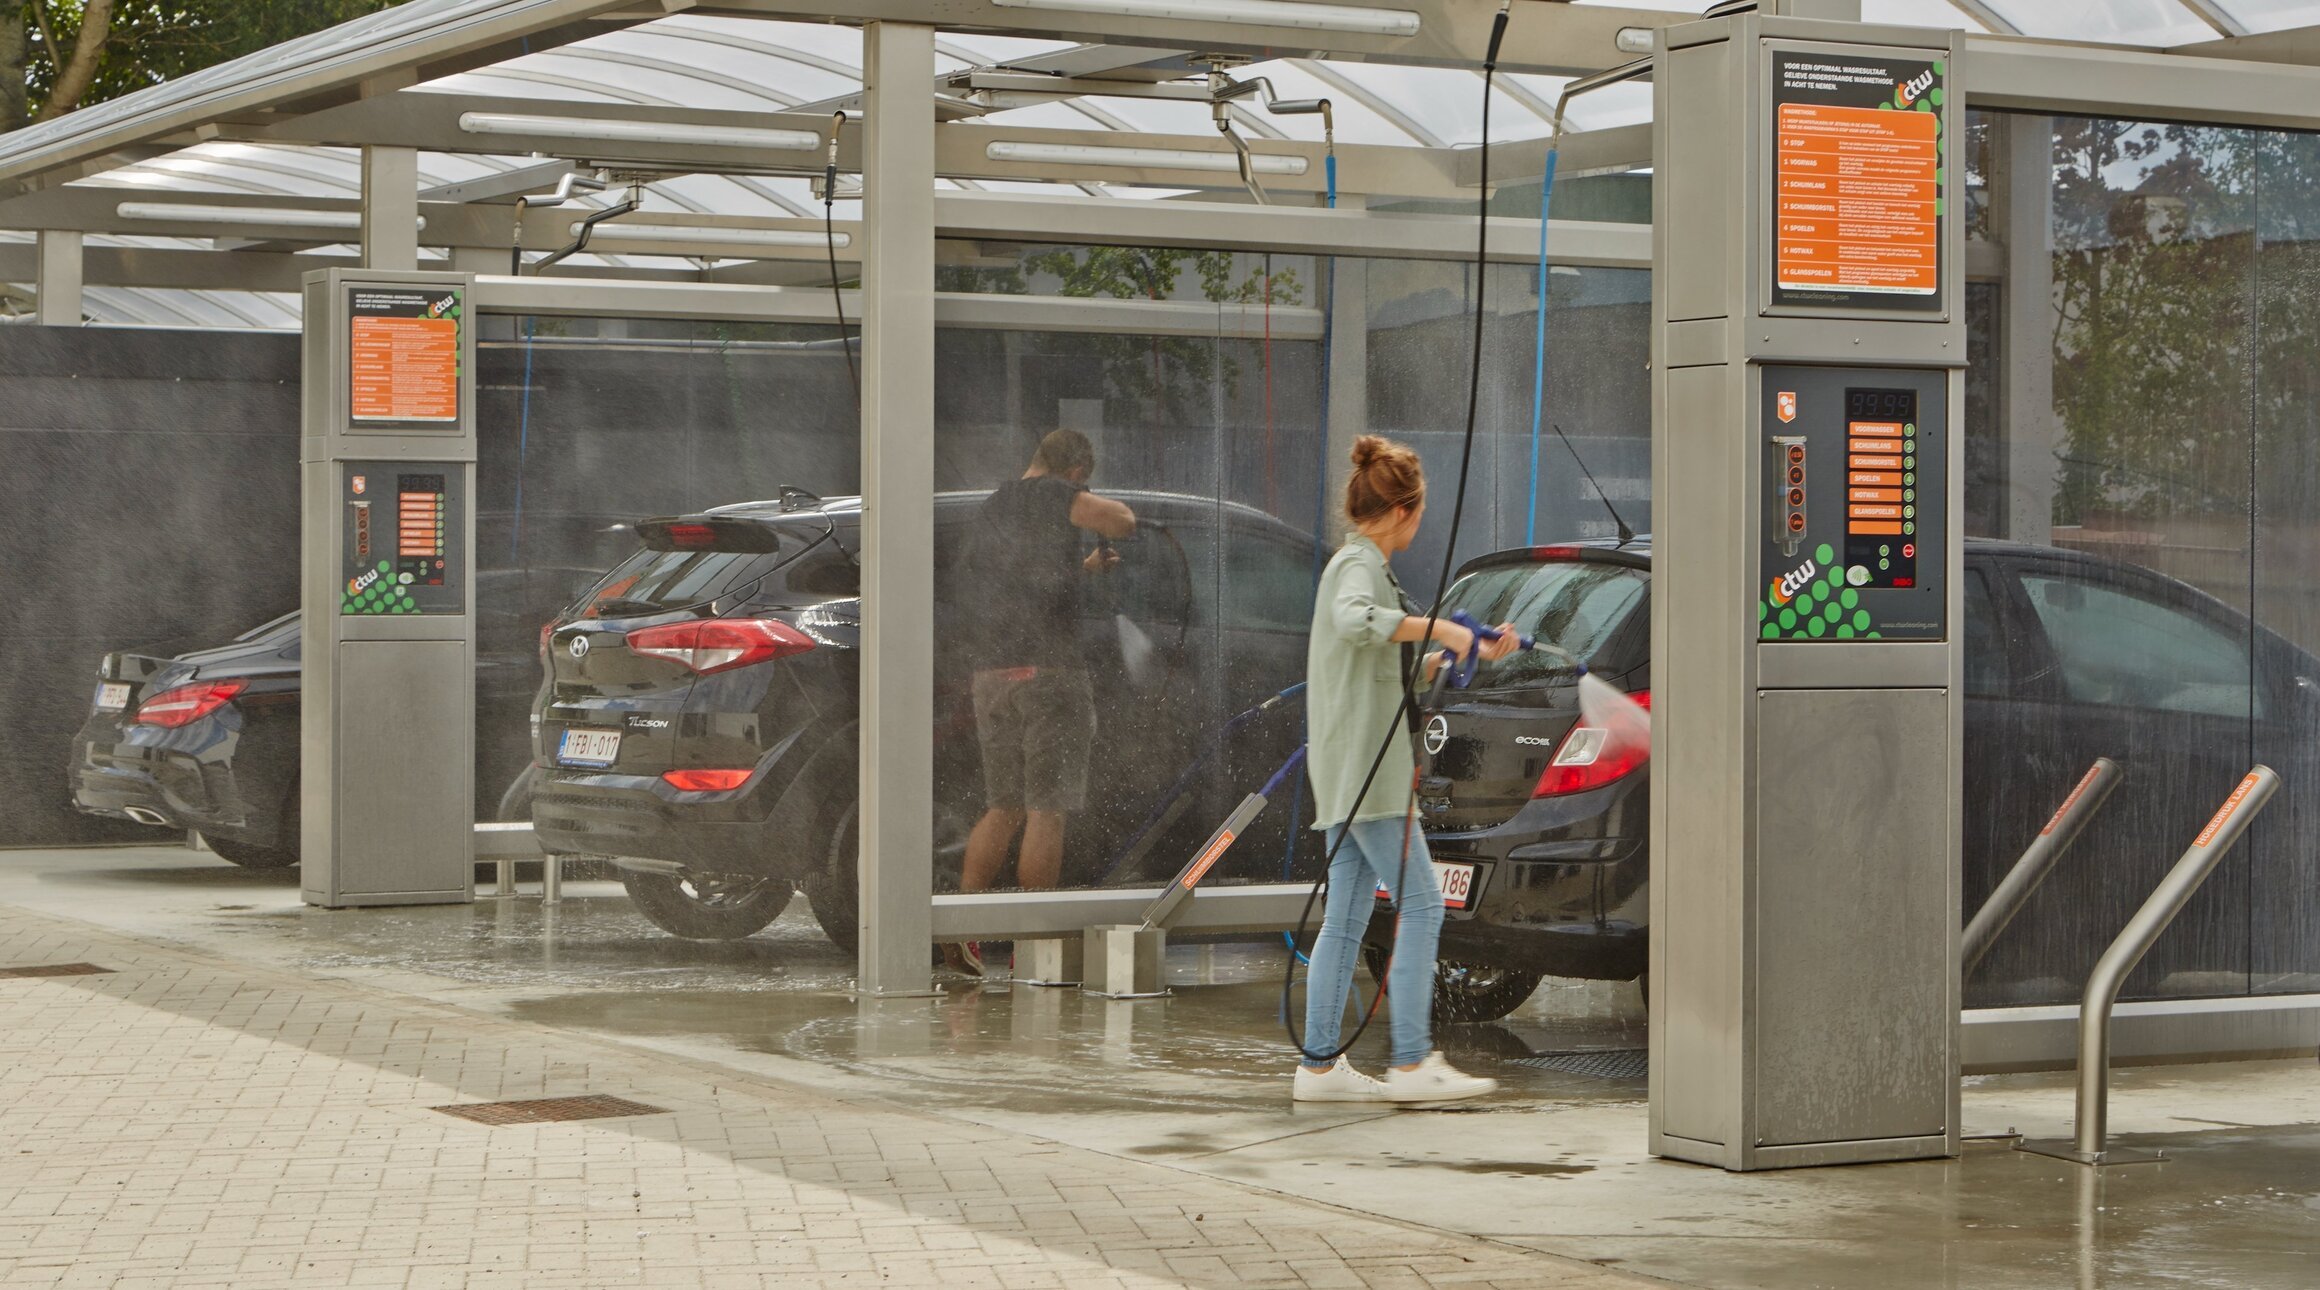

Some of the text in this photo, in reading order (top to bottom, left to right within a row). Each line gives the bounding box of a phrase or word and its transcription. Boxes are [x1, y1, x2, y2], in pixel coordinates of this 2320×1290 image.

[1784, 62, 1800, 70] VOOR
[1801, 63, 1813, 71] EEN
[1813, 64, 1842, 73] OPTIMAAL
[1784, 71, 1894, 85] GELIEVE ONDERSTAANDE WASMETHODE
[1791, 81, 1807, 89] ACHT
[1815, 82, 1838, 90] NEMEN.
[1903, 69, 1934, 101] ctw
[354, 568, 379, 590] ctw
[1780, 559, 1816, 597] ctw
[2197, 779, 2254, 845] HOGEDRUK LANS
[1184, 836, 1231, 887] SCHUIMBORSTEL
[1442, 868, 1471, 896] 186
